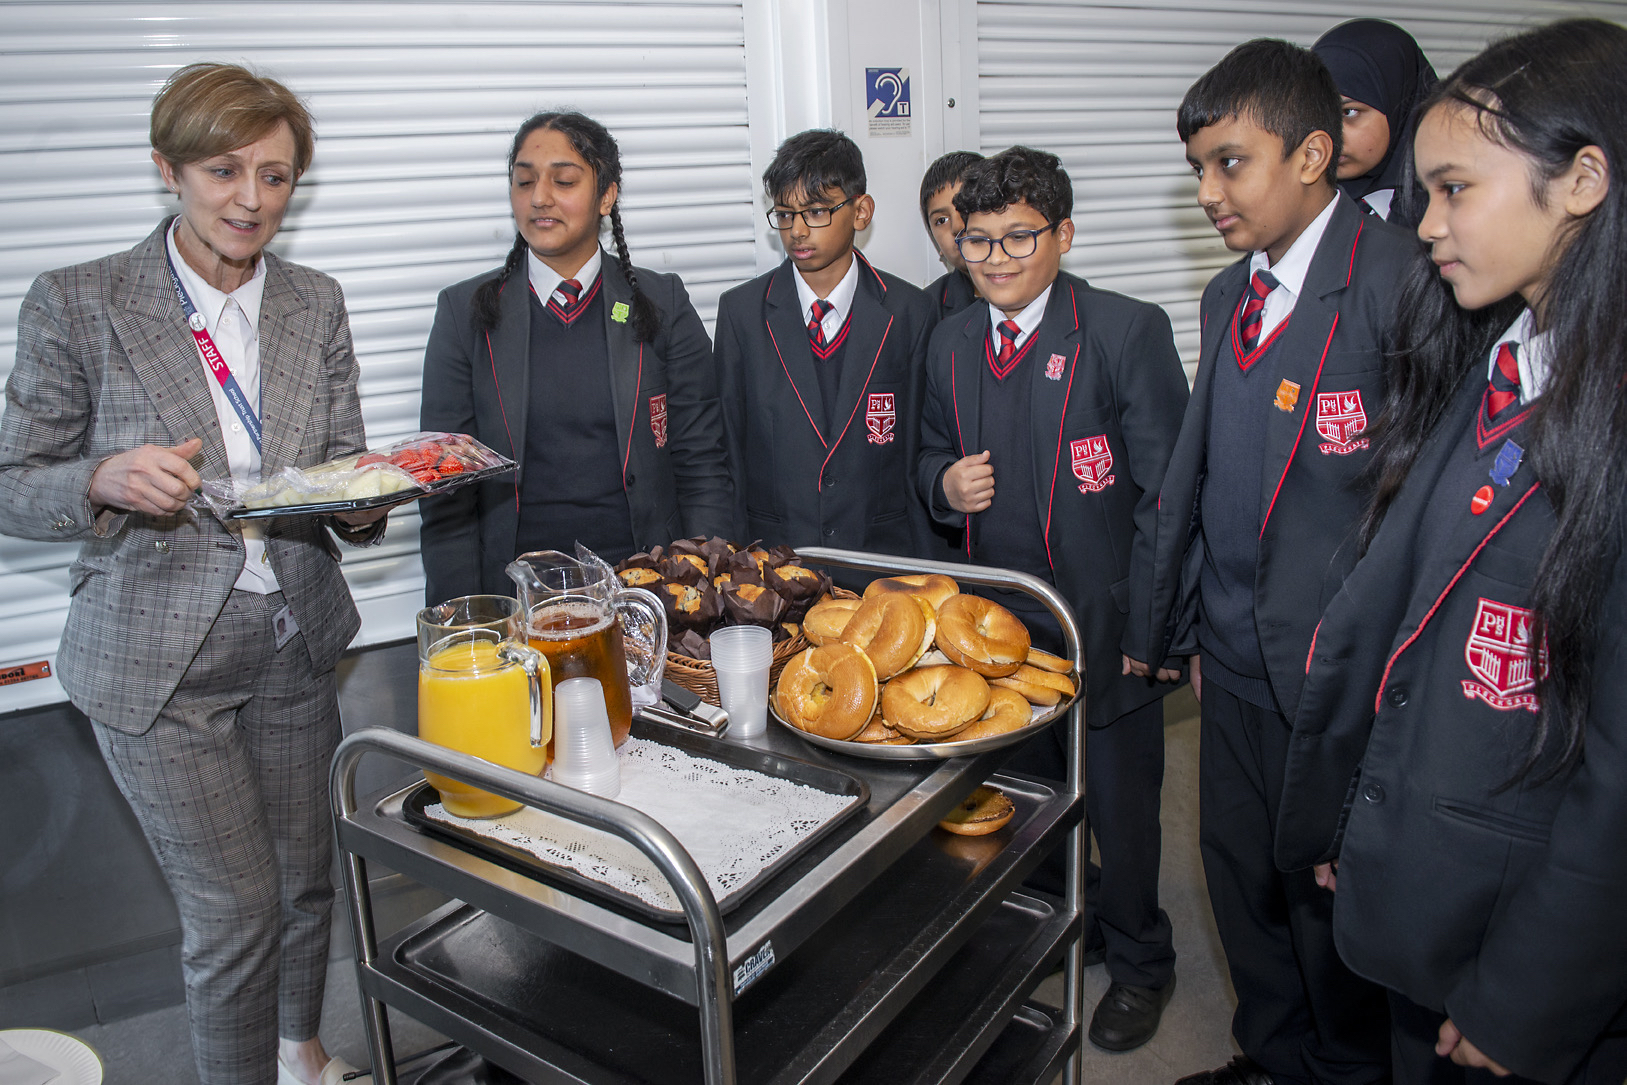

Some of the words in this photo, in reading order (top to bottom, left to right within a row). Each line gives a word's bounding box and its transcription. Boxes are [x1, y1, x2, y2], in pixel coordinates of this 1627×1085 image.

[899, 103, 907, 114] T
[198, 337, 224, 371] STAFF
[229, 388, 241, 404] School
[238, 402, 247, 416] Trust
[1480, 610, 1506, 636] PHS
